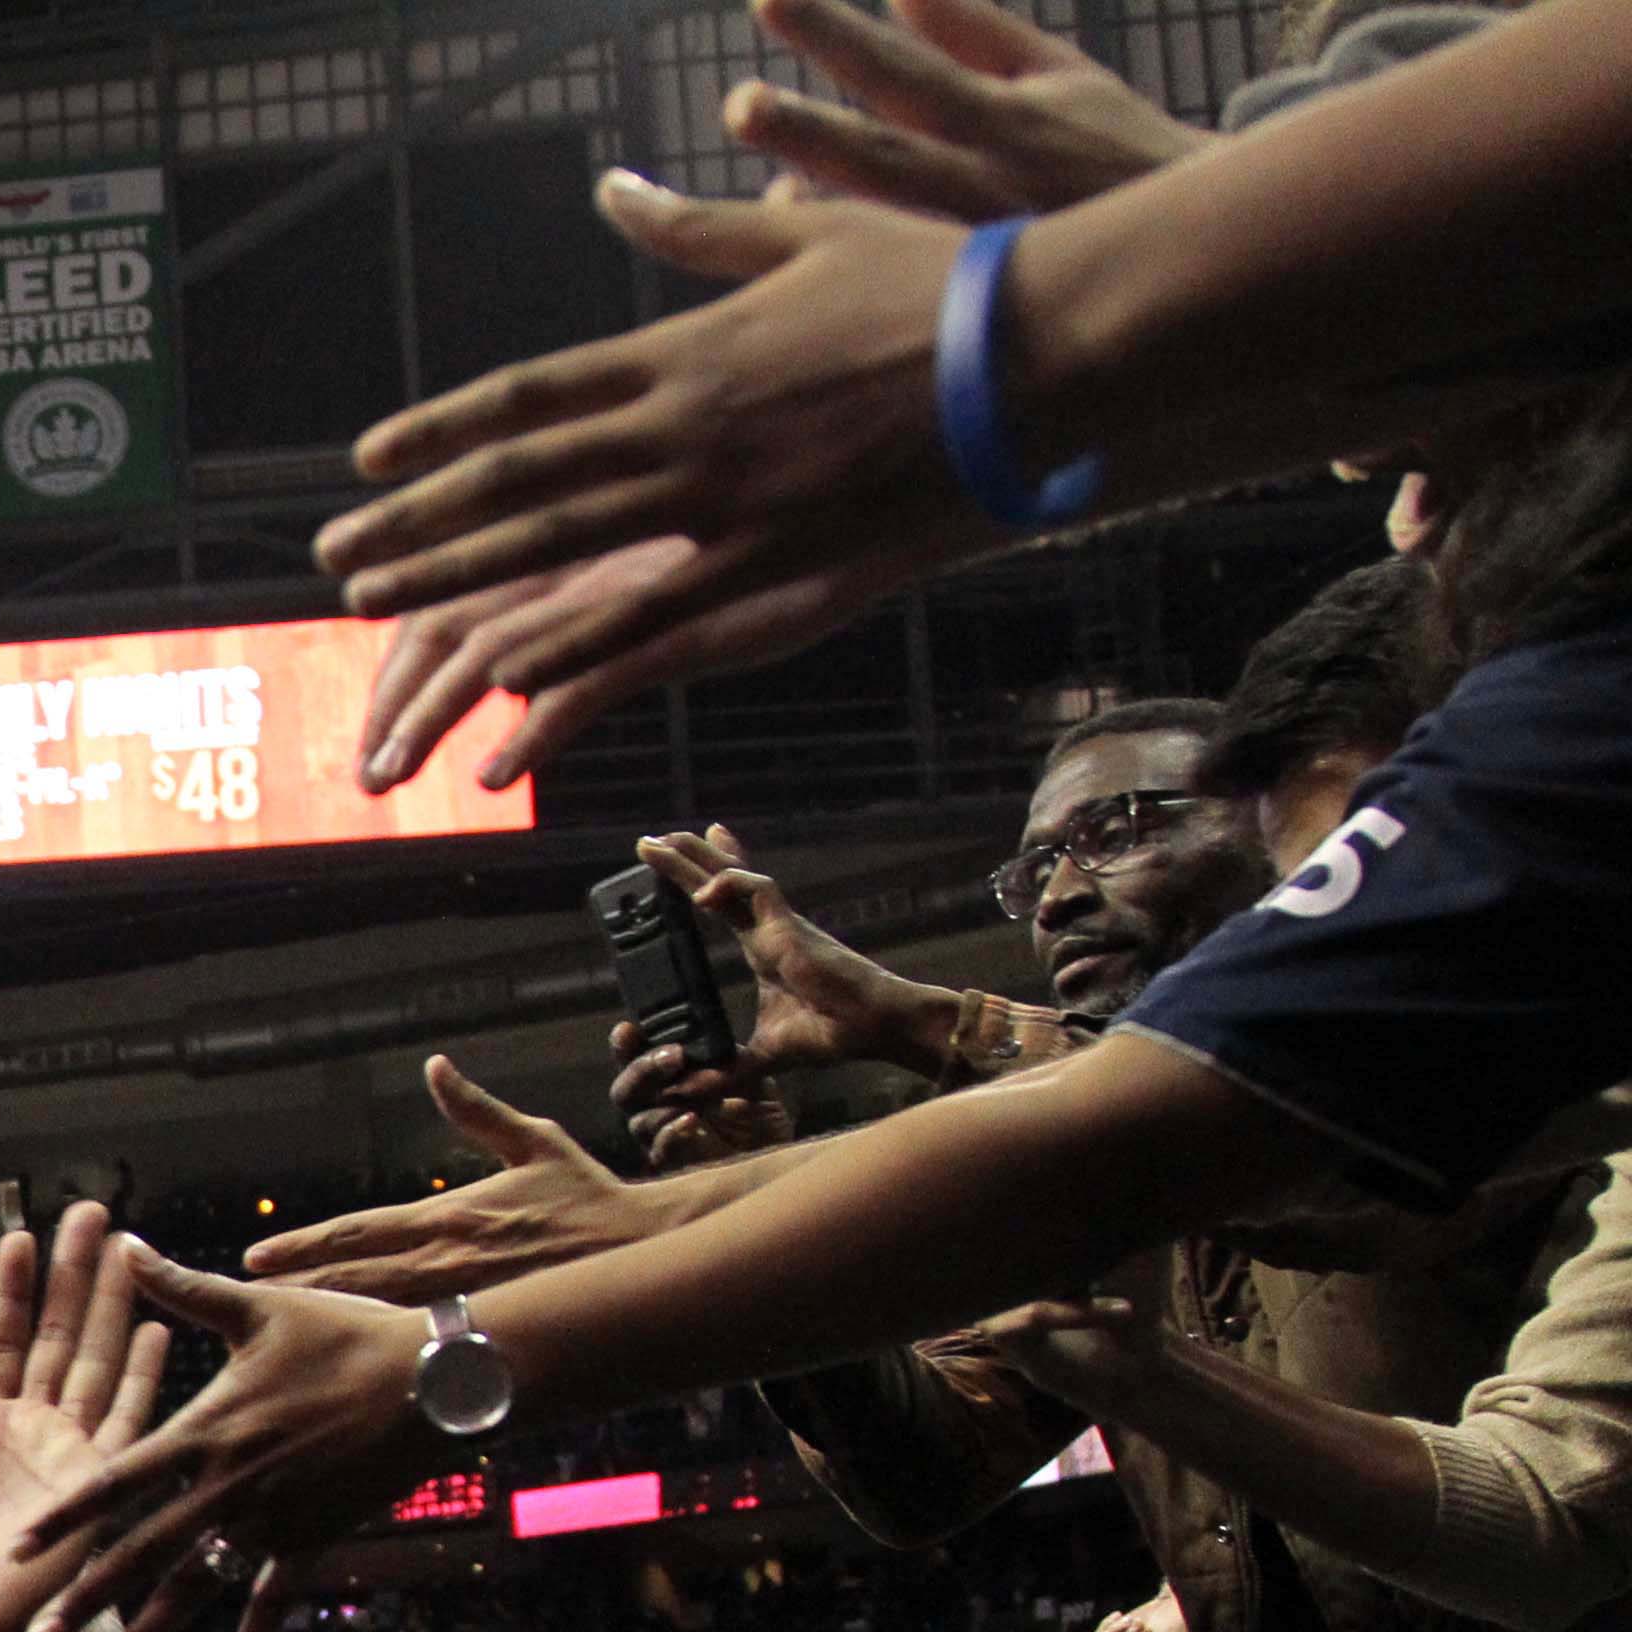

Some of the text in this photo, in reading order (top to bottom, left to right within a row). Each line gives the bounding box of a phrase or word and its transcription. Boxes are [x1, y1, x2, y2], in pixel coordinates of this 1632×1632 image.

[81, 225, 149, 249] FIRST
[39, 335, 152, 370] ARENA
[151, 747, 259, 822] $48
